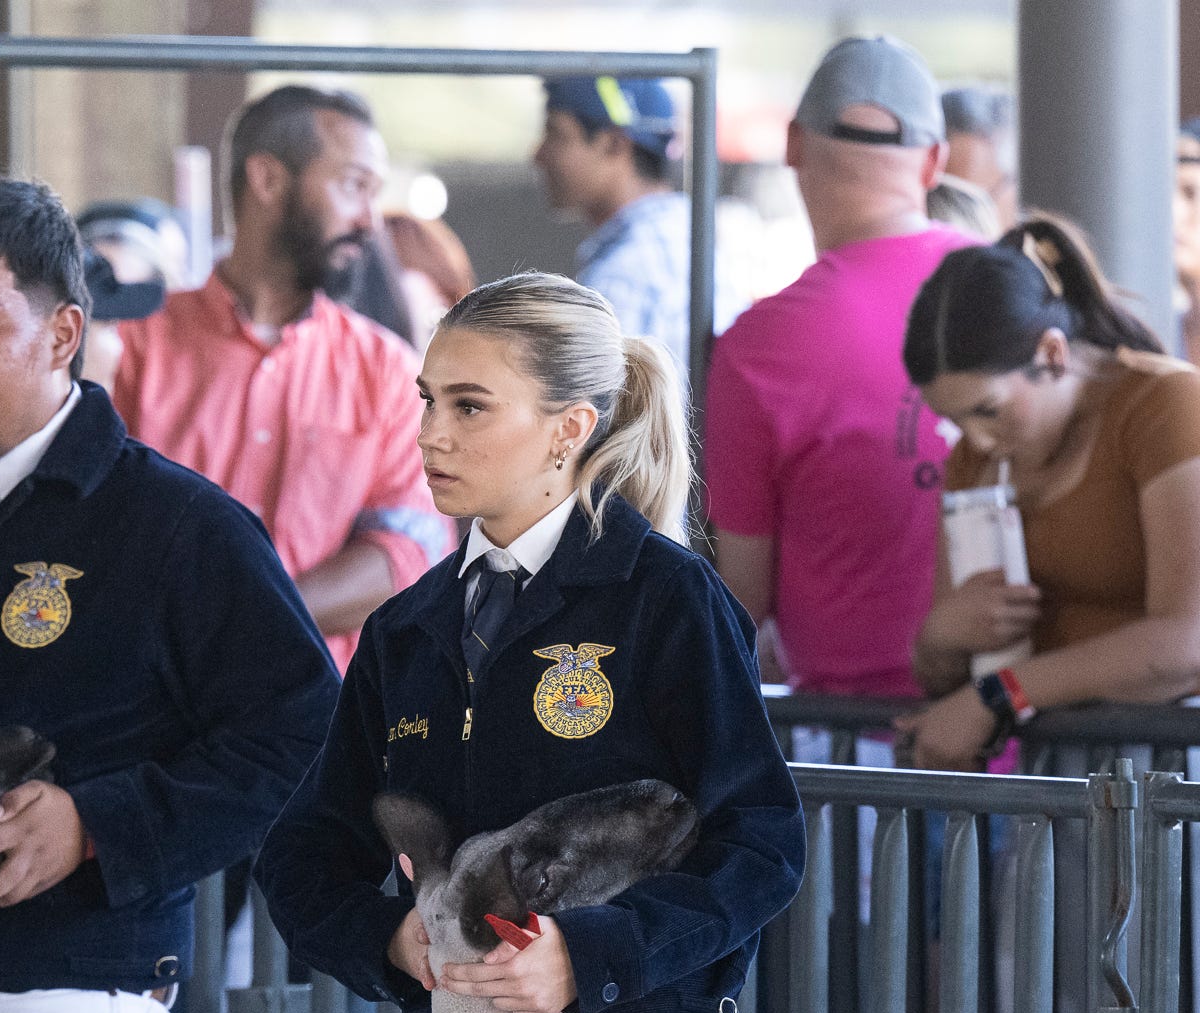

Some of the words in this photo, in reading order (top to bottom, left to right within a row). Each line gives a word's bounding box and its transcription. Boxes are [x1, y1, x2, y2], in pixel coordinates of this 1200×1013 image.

[549, 674, 600, 696] AGRICULTURAL
[561, 684, 589, 695] FFA
[397, 713, 429, 740] Corley
